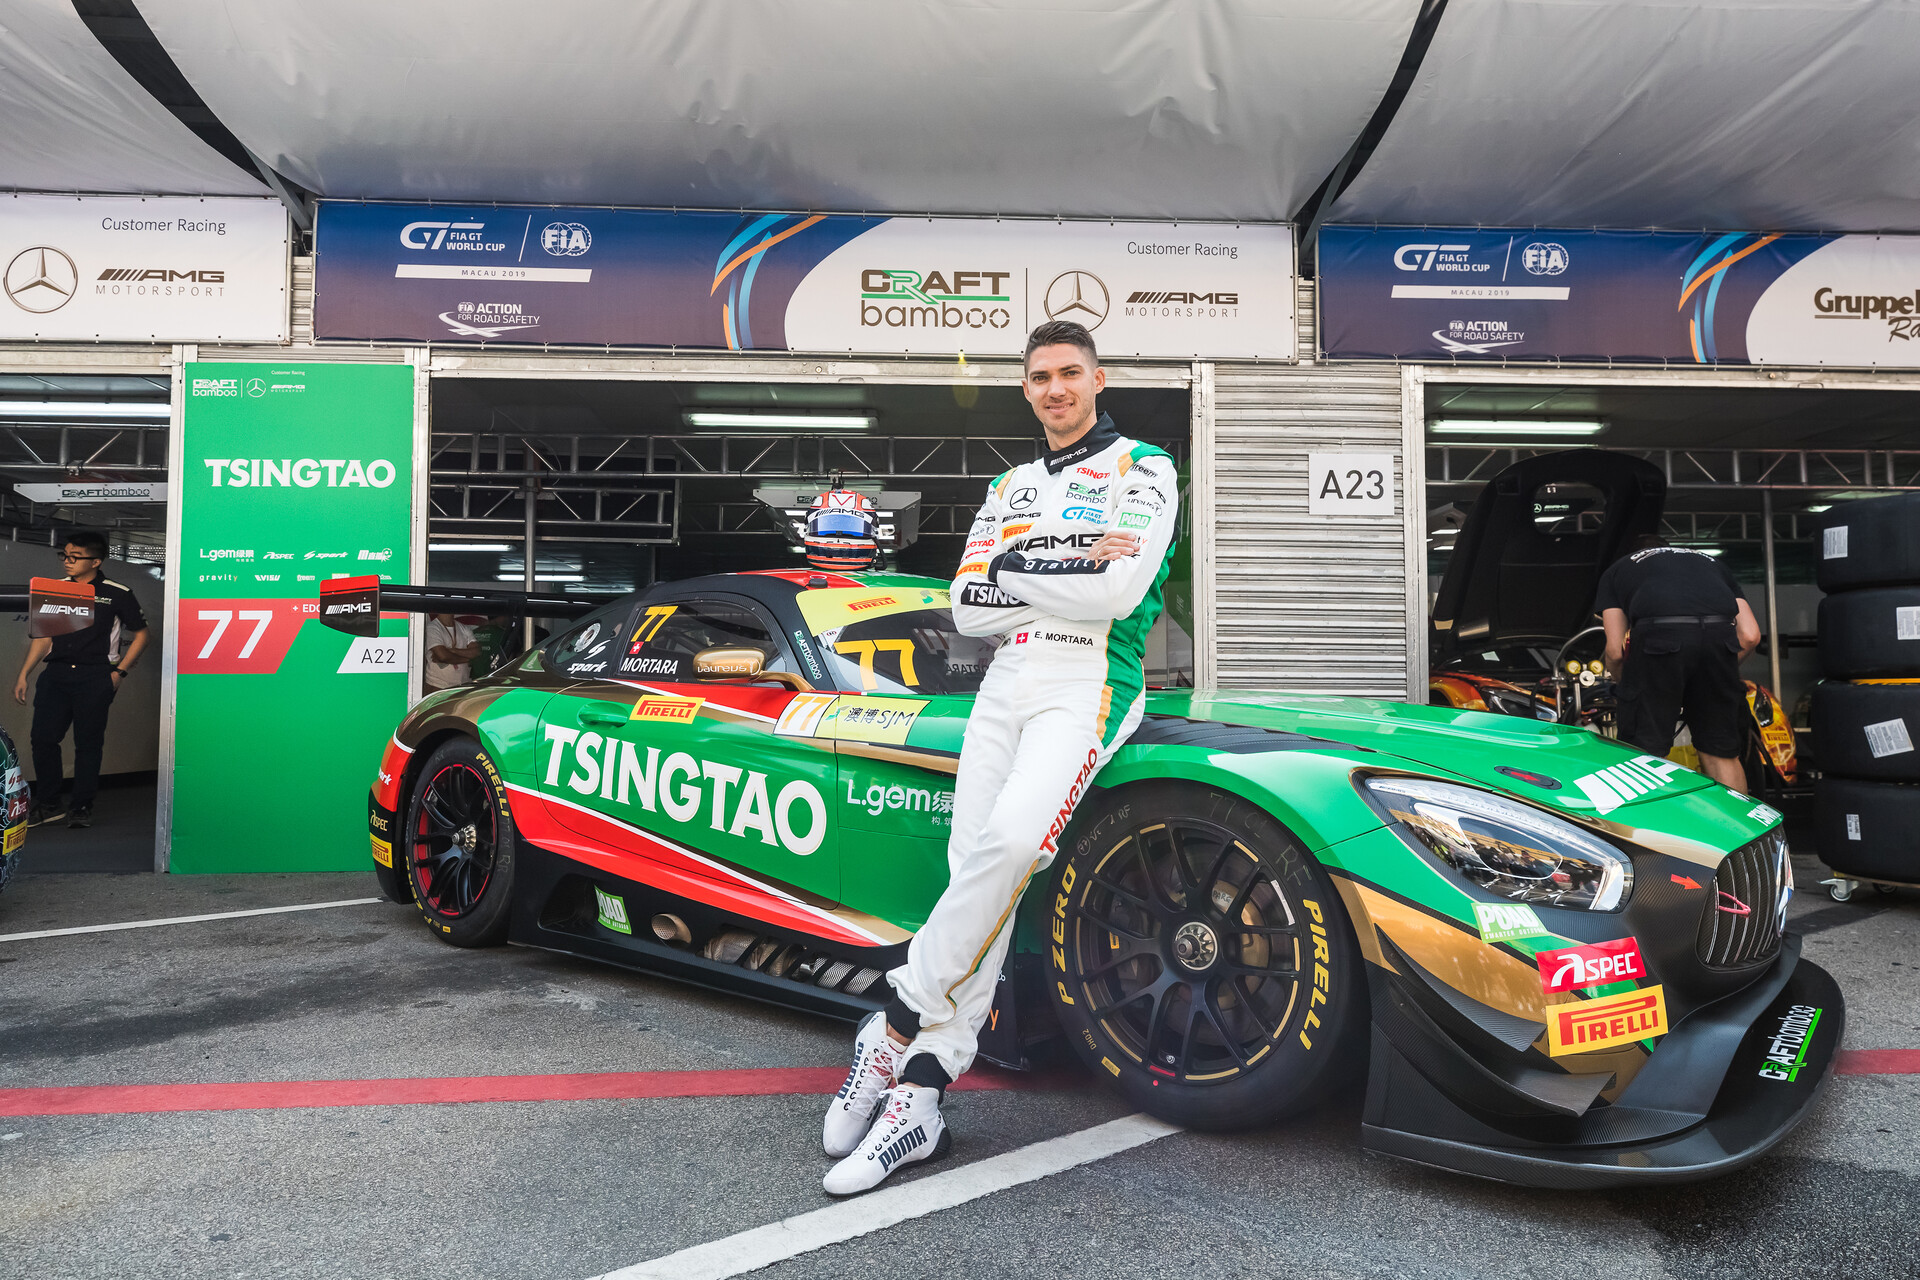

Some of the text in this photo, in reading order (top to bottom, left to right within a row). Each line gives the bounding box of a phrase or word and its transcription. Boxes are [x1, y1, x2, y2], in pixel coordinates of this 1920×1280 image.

[101, 217, 226, 235] Customer Racing
[451, 232, 482, 241] FIA GT
[446, 242, 506, 252] WORLD CUP
[1127, 241, 1238, 259] Customer Racing
[1439, 254, 1469, 262] FIA GT
[461, 269, 526, 278] MACAU 2019
[1435, 263, 1490, 272] WORLD CUP
[135, 269, 225, 283] AMG
[96, 284, 225, 297] MOTORSPORT
[861, 269, 1010, 303] CRAFT
[1158, 292, 1238, 305] AMG
[1814, 287, 1920, 320] Gruppe
[458, 303, 522, 315] FIA ACTION
[861, 300, 1010, 329] bamboo
[1125, 307, 1239, 318] MOTORSPORT
[457, 313, 541, 325] FOR ROAD SAFETY
[1449, 321, 1508, 332] FIA ACTION
[1463, 332, 1489, 340] ROAD
[1490, 332, 1525, 341] SAFETY
[192, 388, 238, 397] bamboo
[203, 458, 397, 488] TSINGTAO
[1076, 467, 1111, 480] TSINGT
[1319, 469, 1385, 500] A23
[1065, 490, 1107, 504] bambo
[1022, 534, 1105, 551] AMG
[1023, 559, 1105, 572] gravity
[199, 574, 238, 582] gravity
[53, 605, 89, 616] AMG
[337, 603, 372, 614] AMG
[847, 597, 897, 612] PIRELLI
[630, 605, 679, 642] 77
[197, 610, 273, 659] 77
[1034, 631, 1094, 647] E. MORTARA
[361, 648, 396, 664] A22
[567, 660, 609, 675] spark
[620, 657, 679, 675] MORTARA
[833, 639, 920, 691] 77
[637, 699, 697, 719] PIRELLI
[780, 695, 833, 732] 77
[843, 707, 915, 730] 澳博 SJM
[475, 751, 510, 817] PIRELLI
[543, 723, 828, 857] TSINGTAO
[847, 778, 931, 816] L.gem
[1038, 748, 1098, 854] TSINGTAO
[1475, 904, 1541, 933] POAD
[1052, 863, 1077, 1006] P ZERO
[1484, 929, 1516, 940] SMARTER
[1300, 899, 1330, 1051] PIRELLI
[1550, 951, 1638, 988] ASPEC
[1558, 994, 1660, 1047] PIRELLI
[877, 1124, 928, 1174] PUMA
